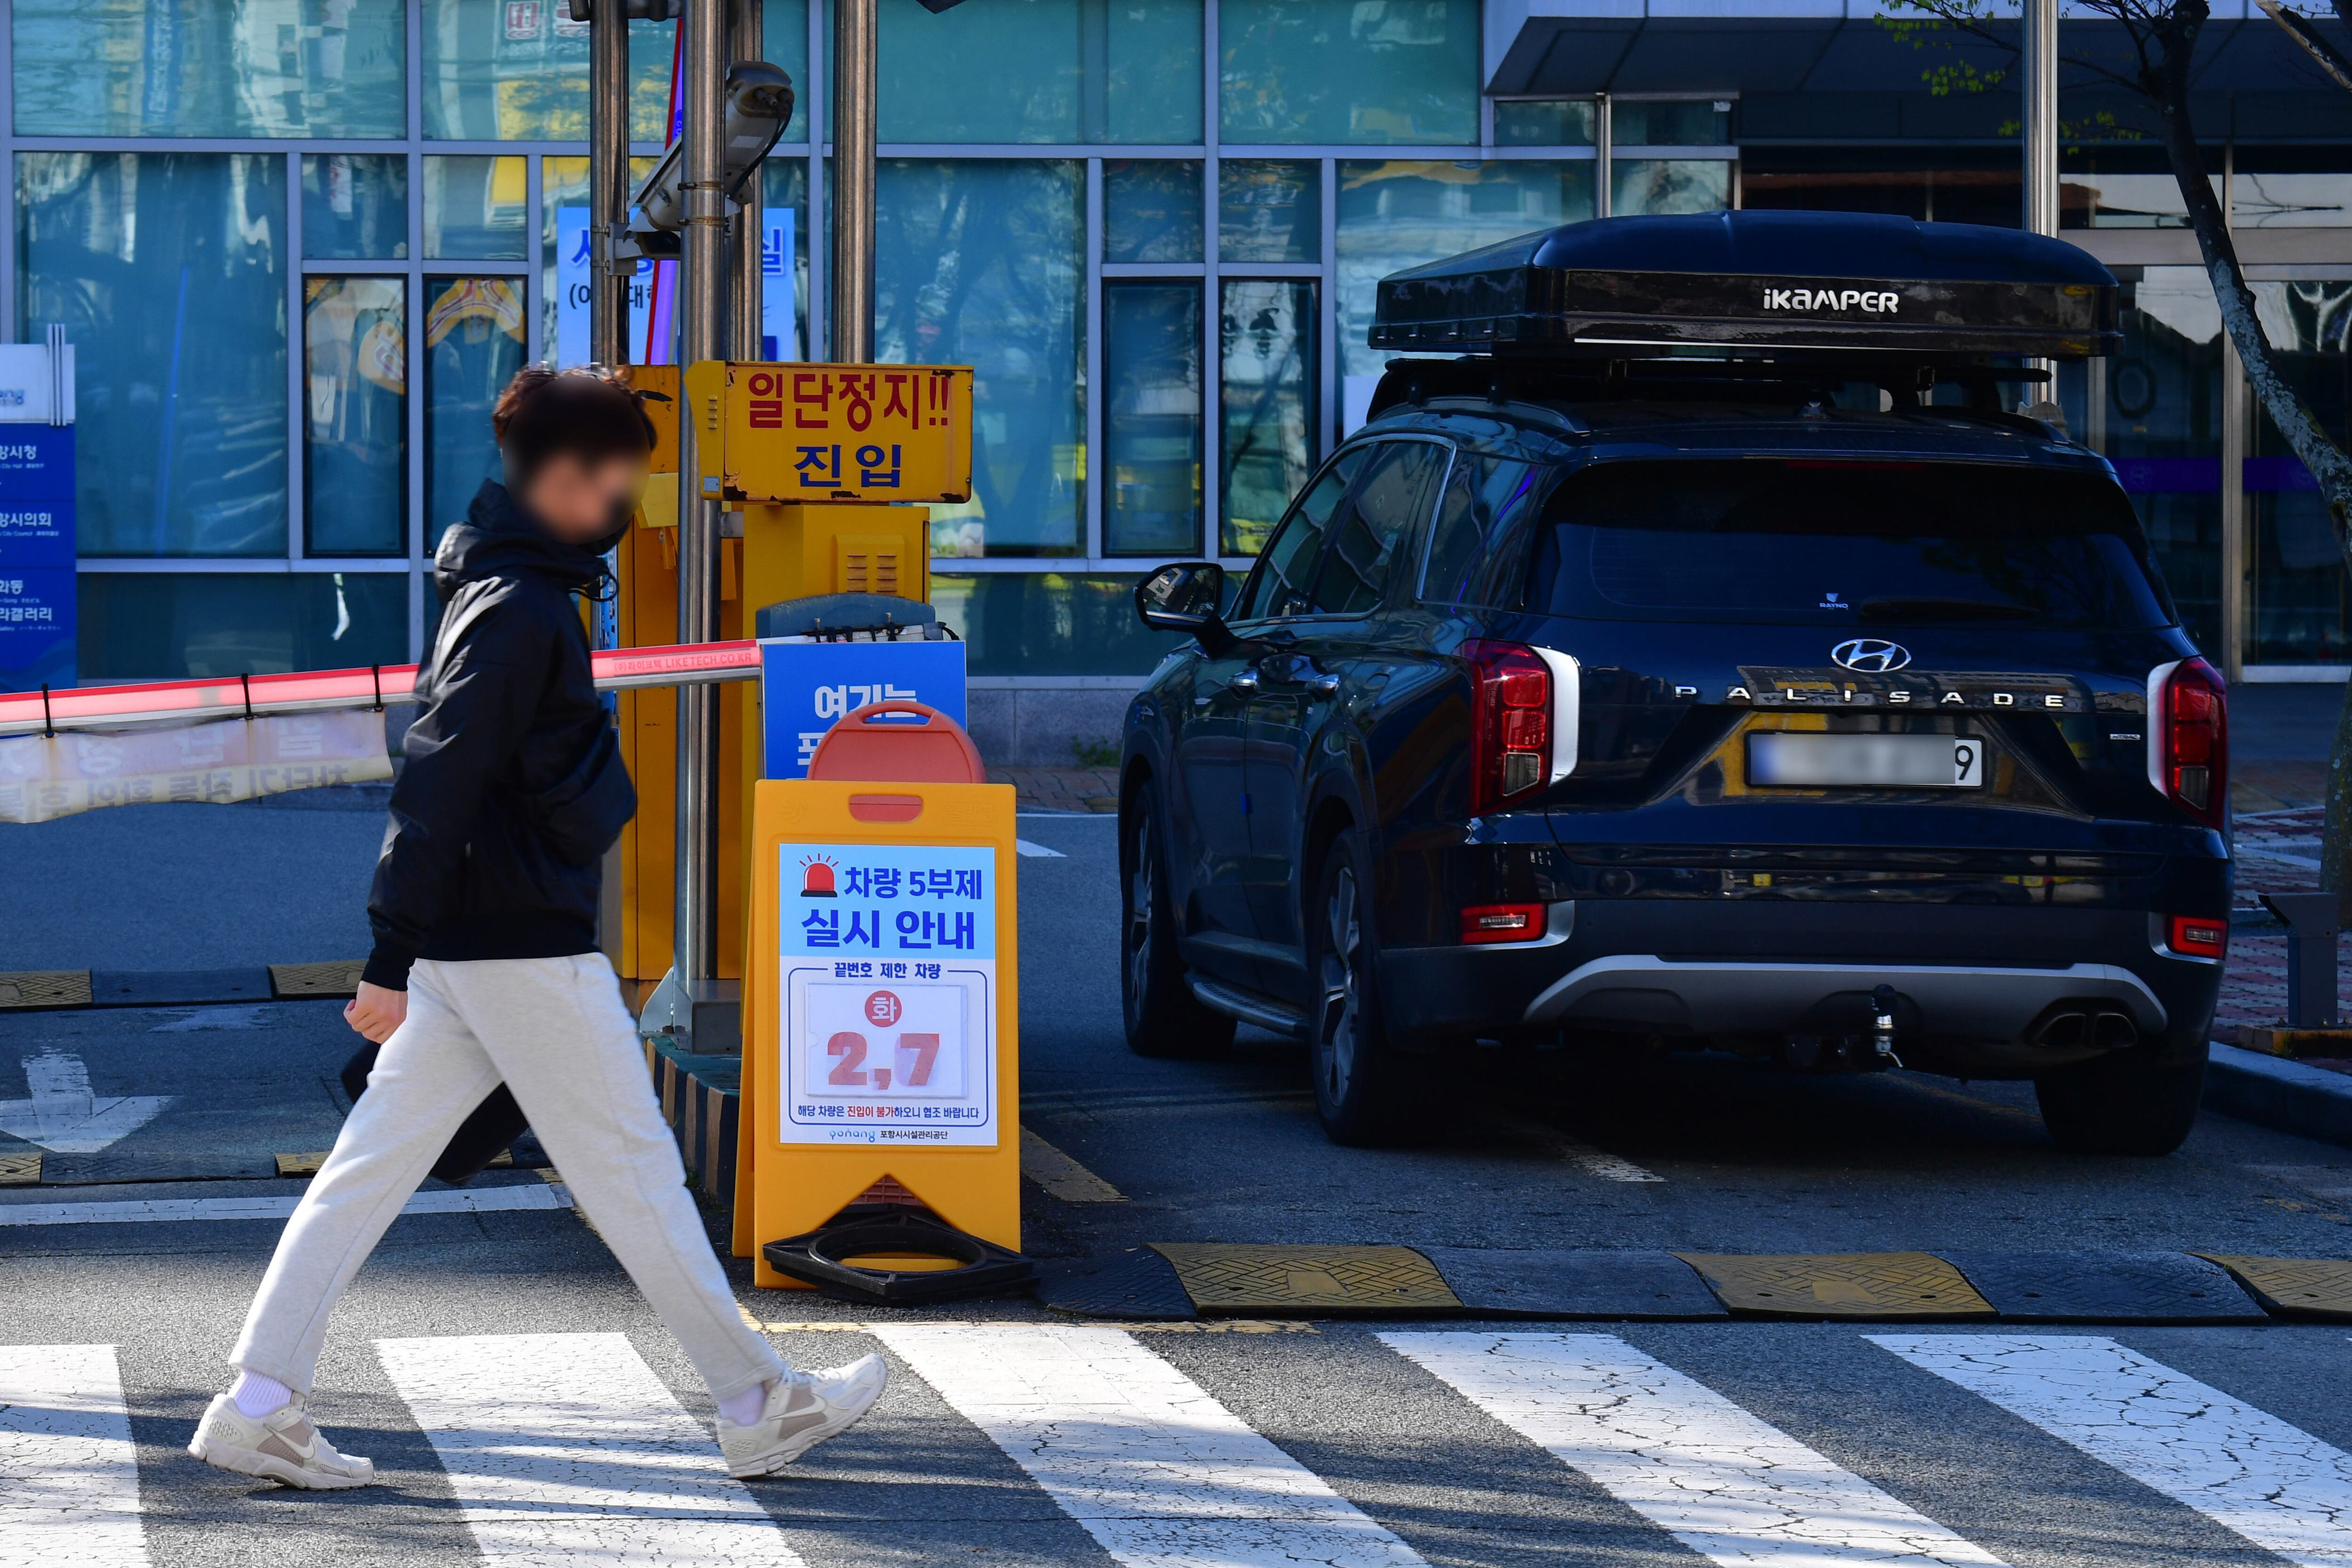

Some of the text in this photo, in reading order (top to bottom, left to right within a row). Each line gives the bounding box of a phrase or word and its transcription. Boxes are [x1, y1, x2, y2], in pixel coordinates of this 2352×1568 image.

[748, 372, 949, 432] 일단정지!!
[793, 443, 902, 488] 진입
[615, 652, 752, 672] (주)라이크텍 LIKETECH.CO.KR
[814, 683, 917, 719] 여기는
[1675, 686, 2064, 707] PALISADE
[844, 866, 983, 900] 차량 5부제
[801, 908, 975, 950] 실시 안내
[834, 962, 941, 980] 끝번호 제한 차량
[871, 996, 898, 1023] 화
[827, 1031, 940, 1090] 2,7
[797, 1105, 979, 1119] 해당 차량은 진입이 불가하오니 협조 바랍니다
[880, 1130, 948, 1140] 포항시시설관리공단
